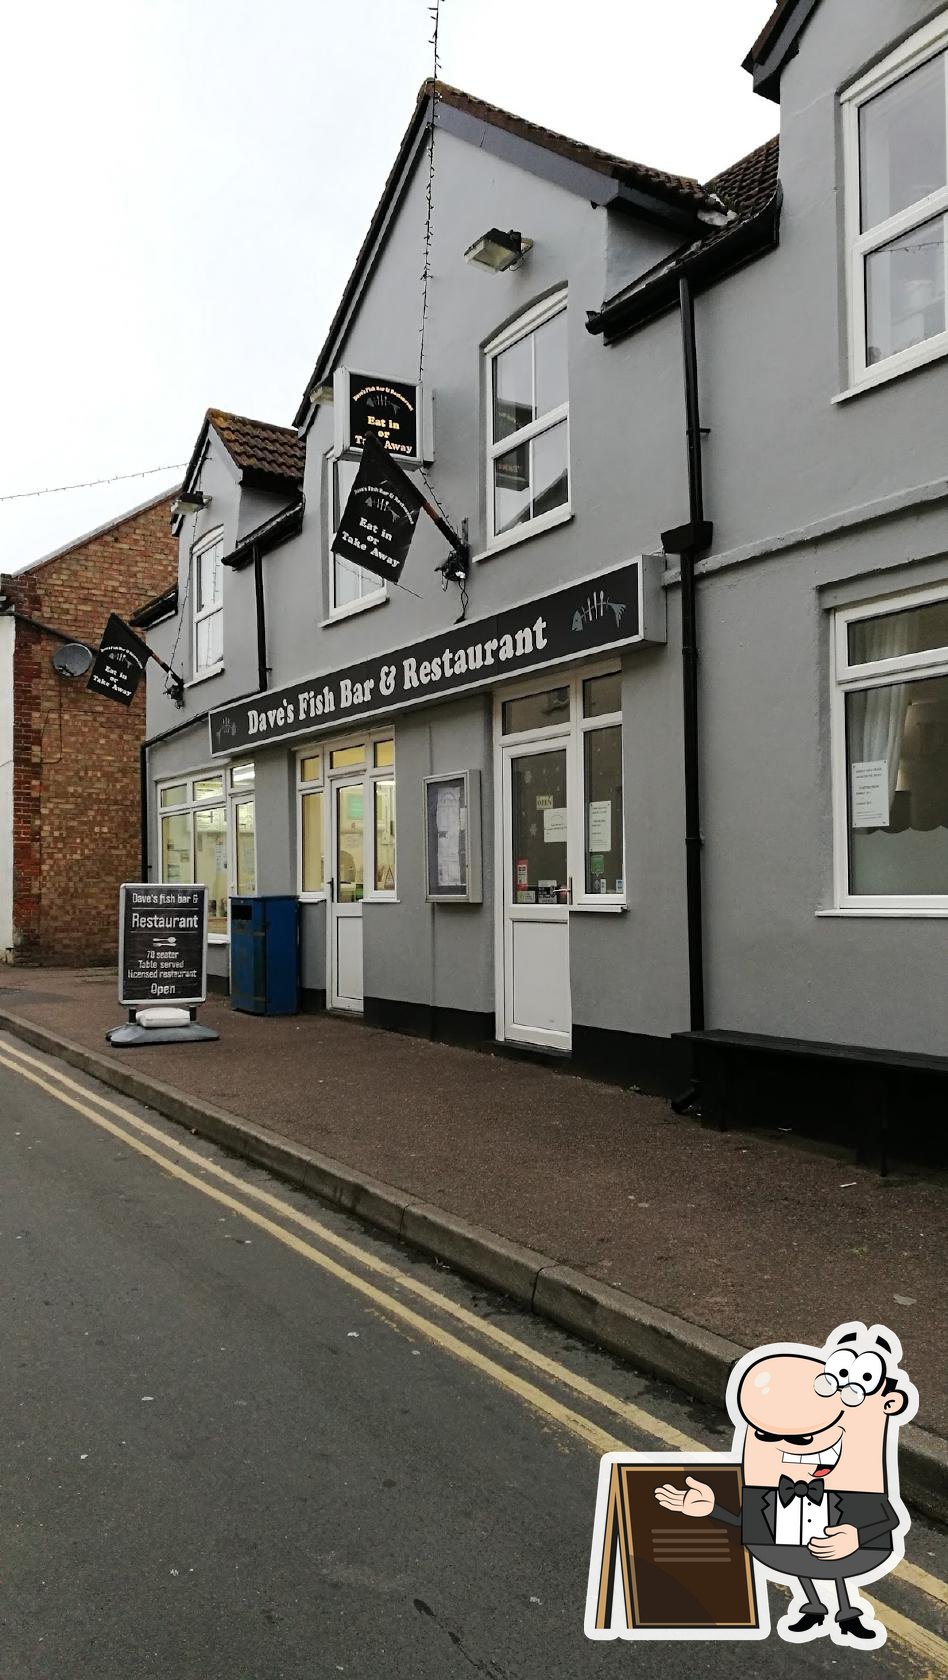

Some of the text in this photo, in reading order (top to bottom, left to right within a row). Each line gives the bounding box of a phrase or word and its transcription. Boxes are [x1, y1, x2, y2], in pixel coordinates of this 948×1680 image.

[367, 415, 400, 430] Eat in
[377, 430, 391, 439] or
[384, 440, 413, 454] Away
[359, 517, 393, 542] Eat in
[366, 535, 380, 545] or
[342, 531, 401, 568] Take Away
[105, 665, 117, 675] Eat
[247, 615, 548, 736] Dave's Fish Bar & Restaurant
[112, 684, 132, 696] Away
[132, 892, 199, 905] Dave's fish bar &
[132, 913, 199, 928] Restaurant
[156, 951, 179, 959] seater
[138, 959, 185, 969] Table served
[159, 969, 198, 979] restaurant
[150, 982, 176, 997] Open
